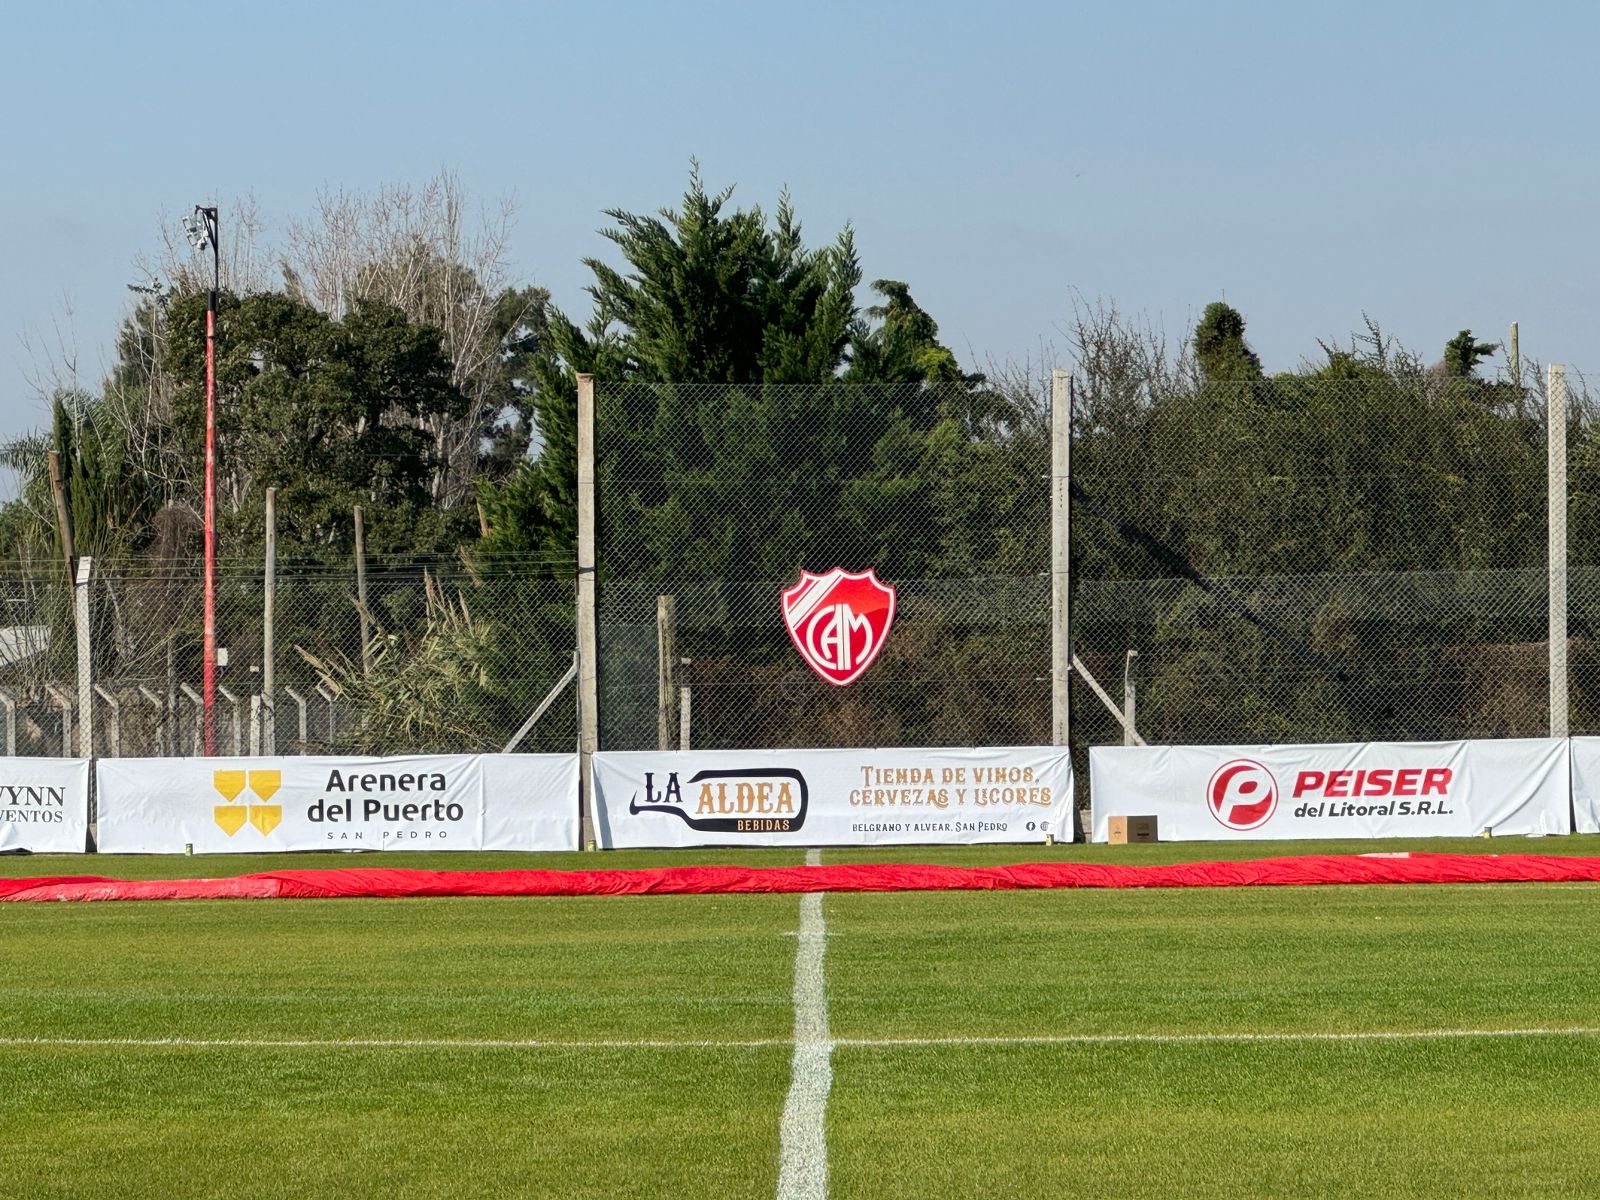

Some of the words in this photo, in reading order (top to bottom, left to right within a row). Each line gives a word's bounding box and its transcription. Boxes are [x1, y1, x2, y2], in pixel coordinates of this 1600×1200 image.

[326, 769, 446, 792] Arenera
[942, 767, 966, 785] DE
[1292, 768, 1453, 798] PEISER
[0, 786, 66, 806] YNN
[644, 772, 683, 803] LA
[695, 782, 795, 814] ALDEA
[849, 788, 950, 809] CERVEZAS
[955, 788, 968, 806] Y
[974, 787, 1052, 806] LICORES
[308, 799, 351, 823] del
[363, 799, 464, 822] Puerto
[1294, 802, 1325, 818] del
[1328, 800, 1395, 818] Litoral
[1397, 800, 1454, 816] S.R.L.
[327, 832, 363, 840] SAN
[383, 831, 448, 839] PEDRO
[737, 820, 790, 831] BEBIDAS
[852, 823, 902, 832] BELGRANO
[905, 823, 911, 832] Y
